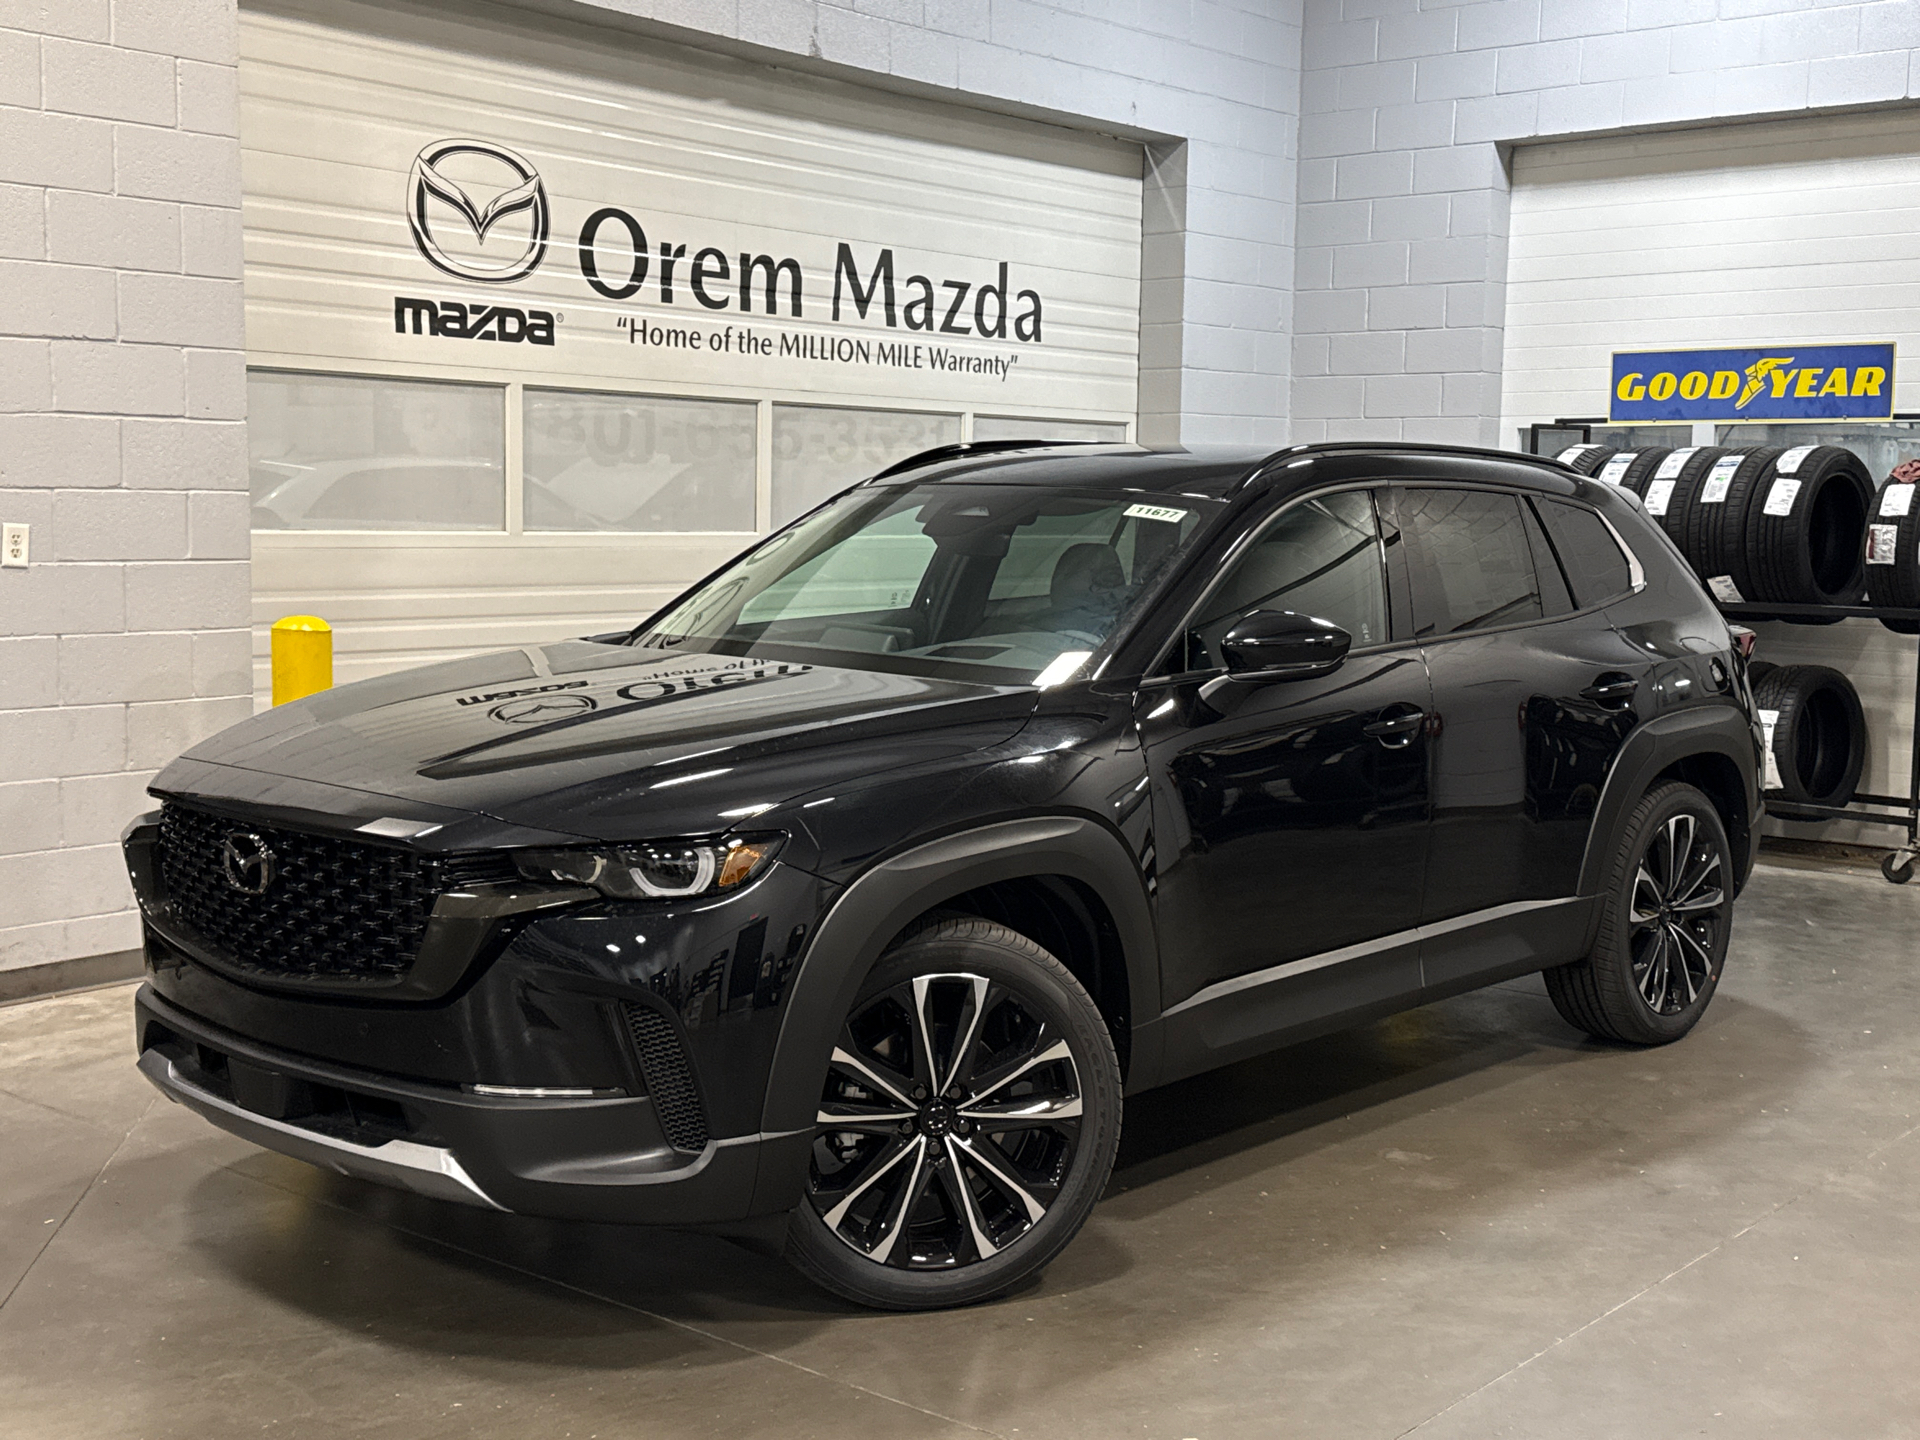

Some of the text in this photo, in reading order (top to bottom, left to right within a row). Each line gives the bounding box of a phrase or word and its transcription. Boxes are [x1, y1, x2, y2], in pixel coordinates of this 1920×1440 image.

[577, 207, 1042, 342] Orem Mazda
[394, 296, 555, 346] mazda
[616, 317, 701, 350] “Home
[709, 326, 733, 352] of
[737, 328, 772, 356] the
[779, 333, 870, 364] MILLION
[877, 342, 923, 369] MILE
[1136, 506, 1179, 518] 11677
